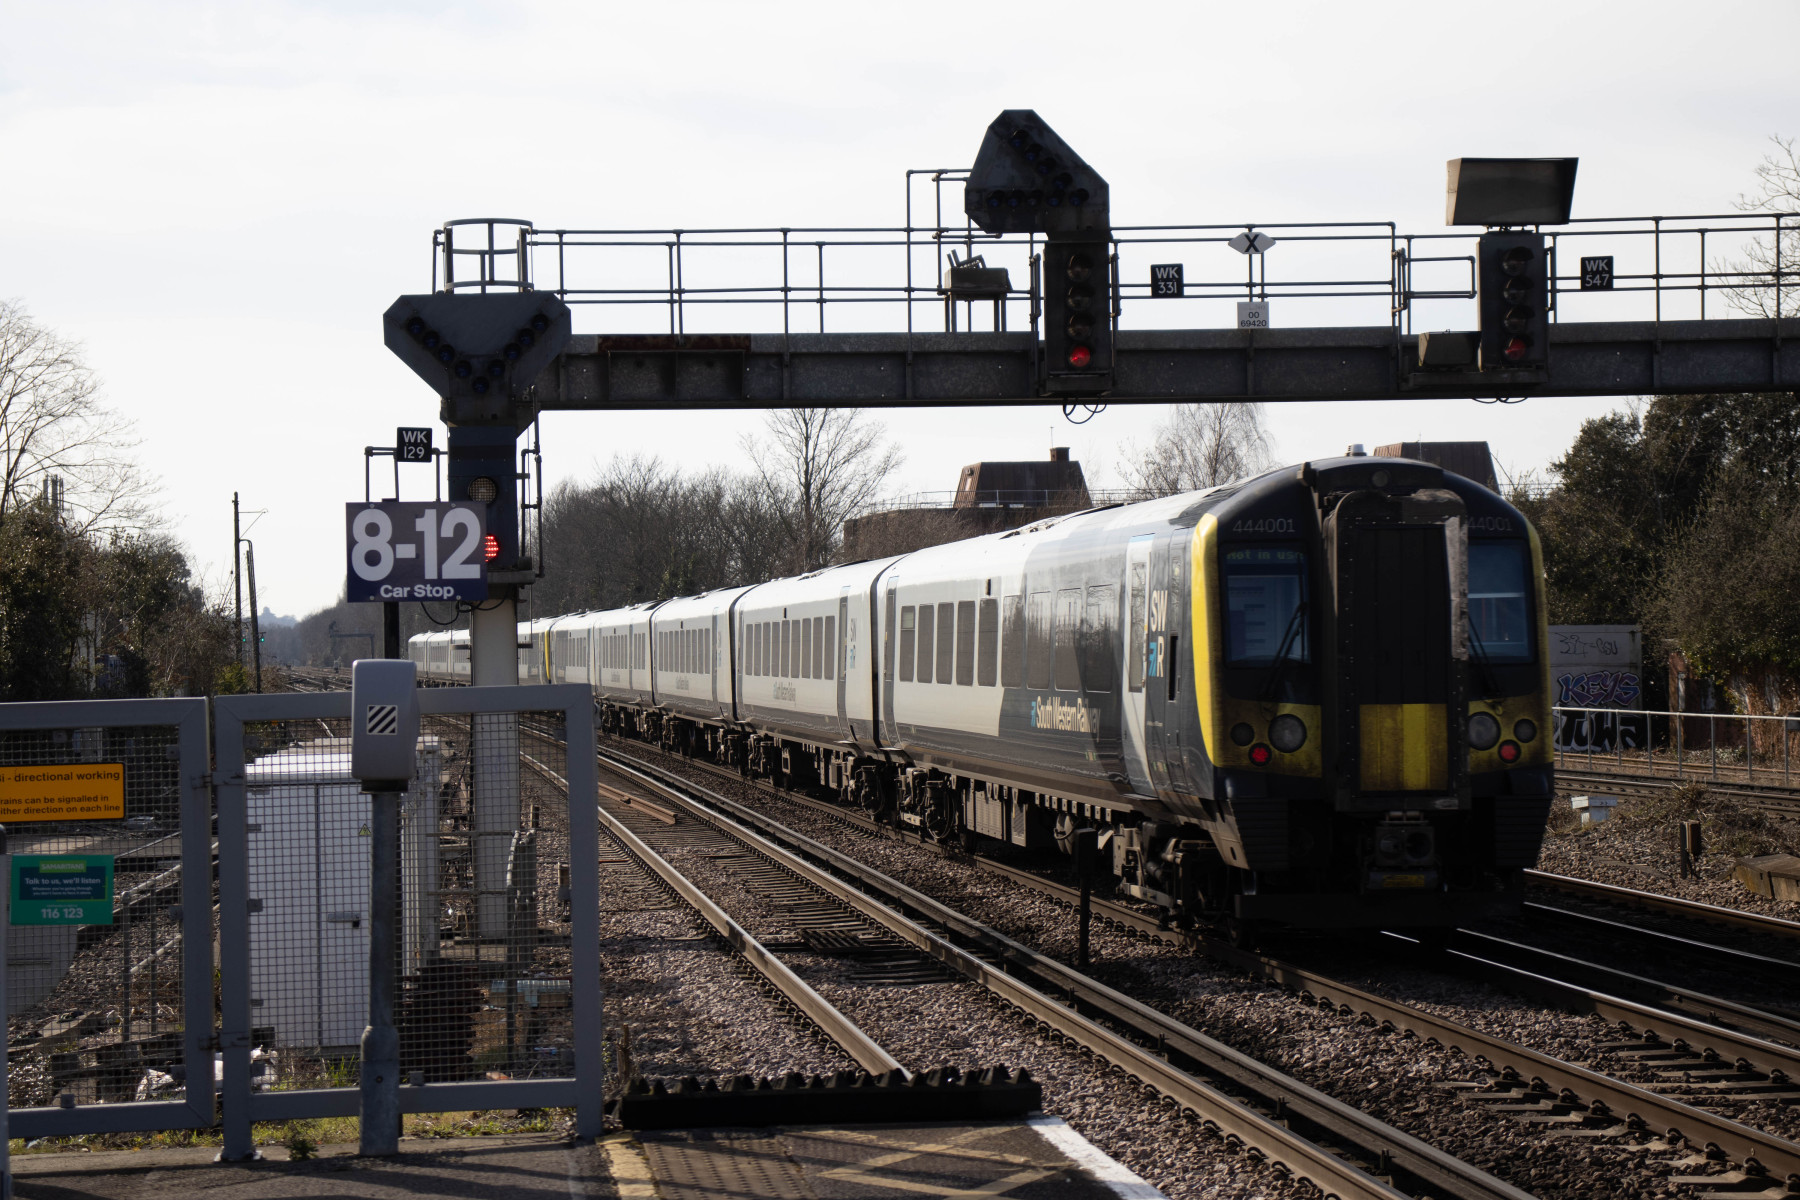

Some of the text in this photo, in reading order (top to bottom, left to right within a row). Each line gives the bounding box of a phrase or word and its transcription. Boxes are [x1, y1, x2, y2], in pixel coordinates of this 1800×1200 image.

[1244, 233, 1260, 253] X
[1585, 259, 1609, 272] WK
[1155, 267, 1179, 279] WK
[1585, 273, 1610, 287] 547
[1158, 281, 1178, 294] 331
[1240, 319, 1267, 328] 69420
[402, 430, 428, 443] WK
[403, 446, 425, 459] 129
[1232, 518, 1296, 533] 444001
[1467, 516, 1513, 531] 44001
[351, 507, 481, 582] 8-12
[1257, 549, 1271, 560] in
[380, 583, 455, 599] Car Stop
[1151, 589, 1168, 632] SW
[1558, 671, 1640, 706] KEYS
[1036, 695, 1053, 729] South
[1053, 696, 1077, 732] Western
[14, 771, 73, 782] directional
[76, 770, 120, 781] working
[0, 796, 22, 805] rains
[44, 795, 55, 803] be
[57, 794, 98, 804] signalled
[100, 794, 109, 802] in
[0, 806, 21, 815] ither
[24, 806, 64, 814] direction
[80, 804, 102, 812] each
[24, 877, 40, 885] Talk
[40, 907, 84, 919] 116 123
